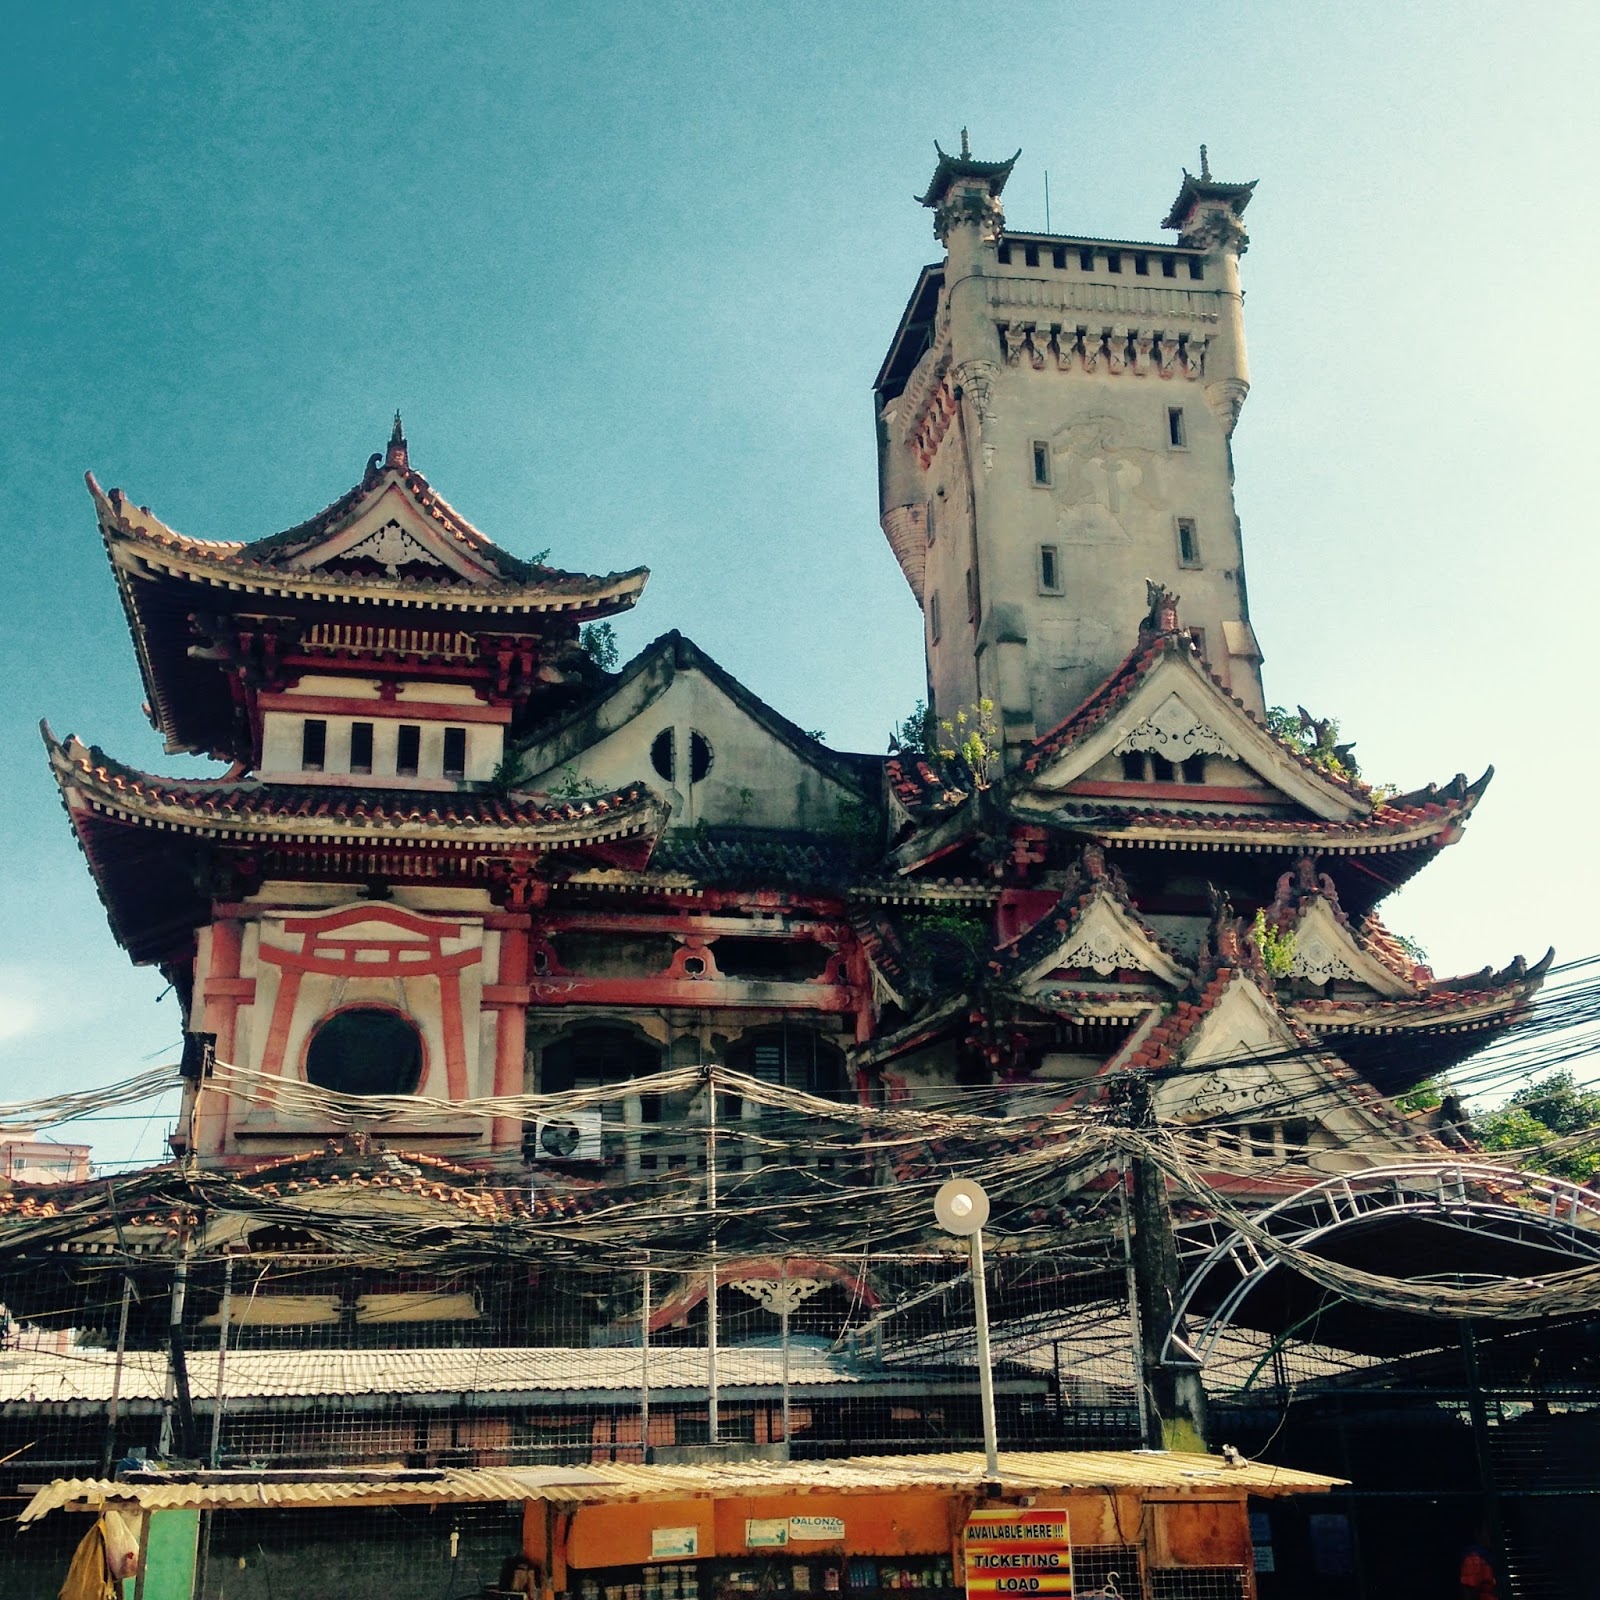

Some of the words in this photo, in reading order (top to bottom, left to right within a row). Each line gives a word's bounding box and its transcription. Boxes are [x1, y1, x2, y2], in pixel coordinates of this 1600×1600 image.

[968, 1525, 1023, 1539] AVAILABLE
[1026, 1524, 1052, 1538] HERE
[974, 1553, 1059, 1568] TICKETING
[997, 1578, 1039, 1591] LOAD
